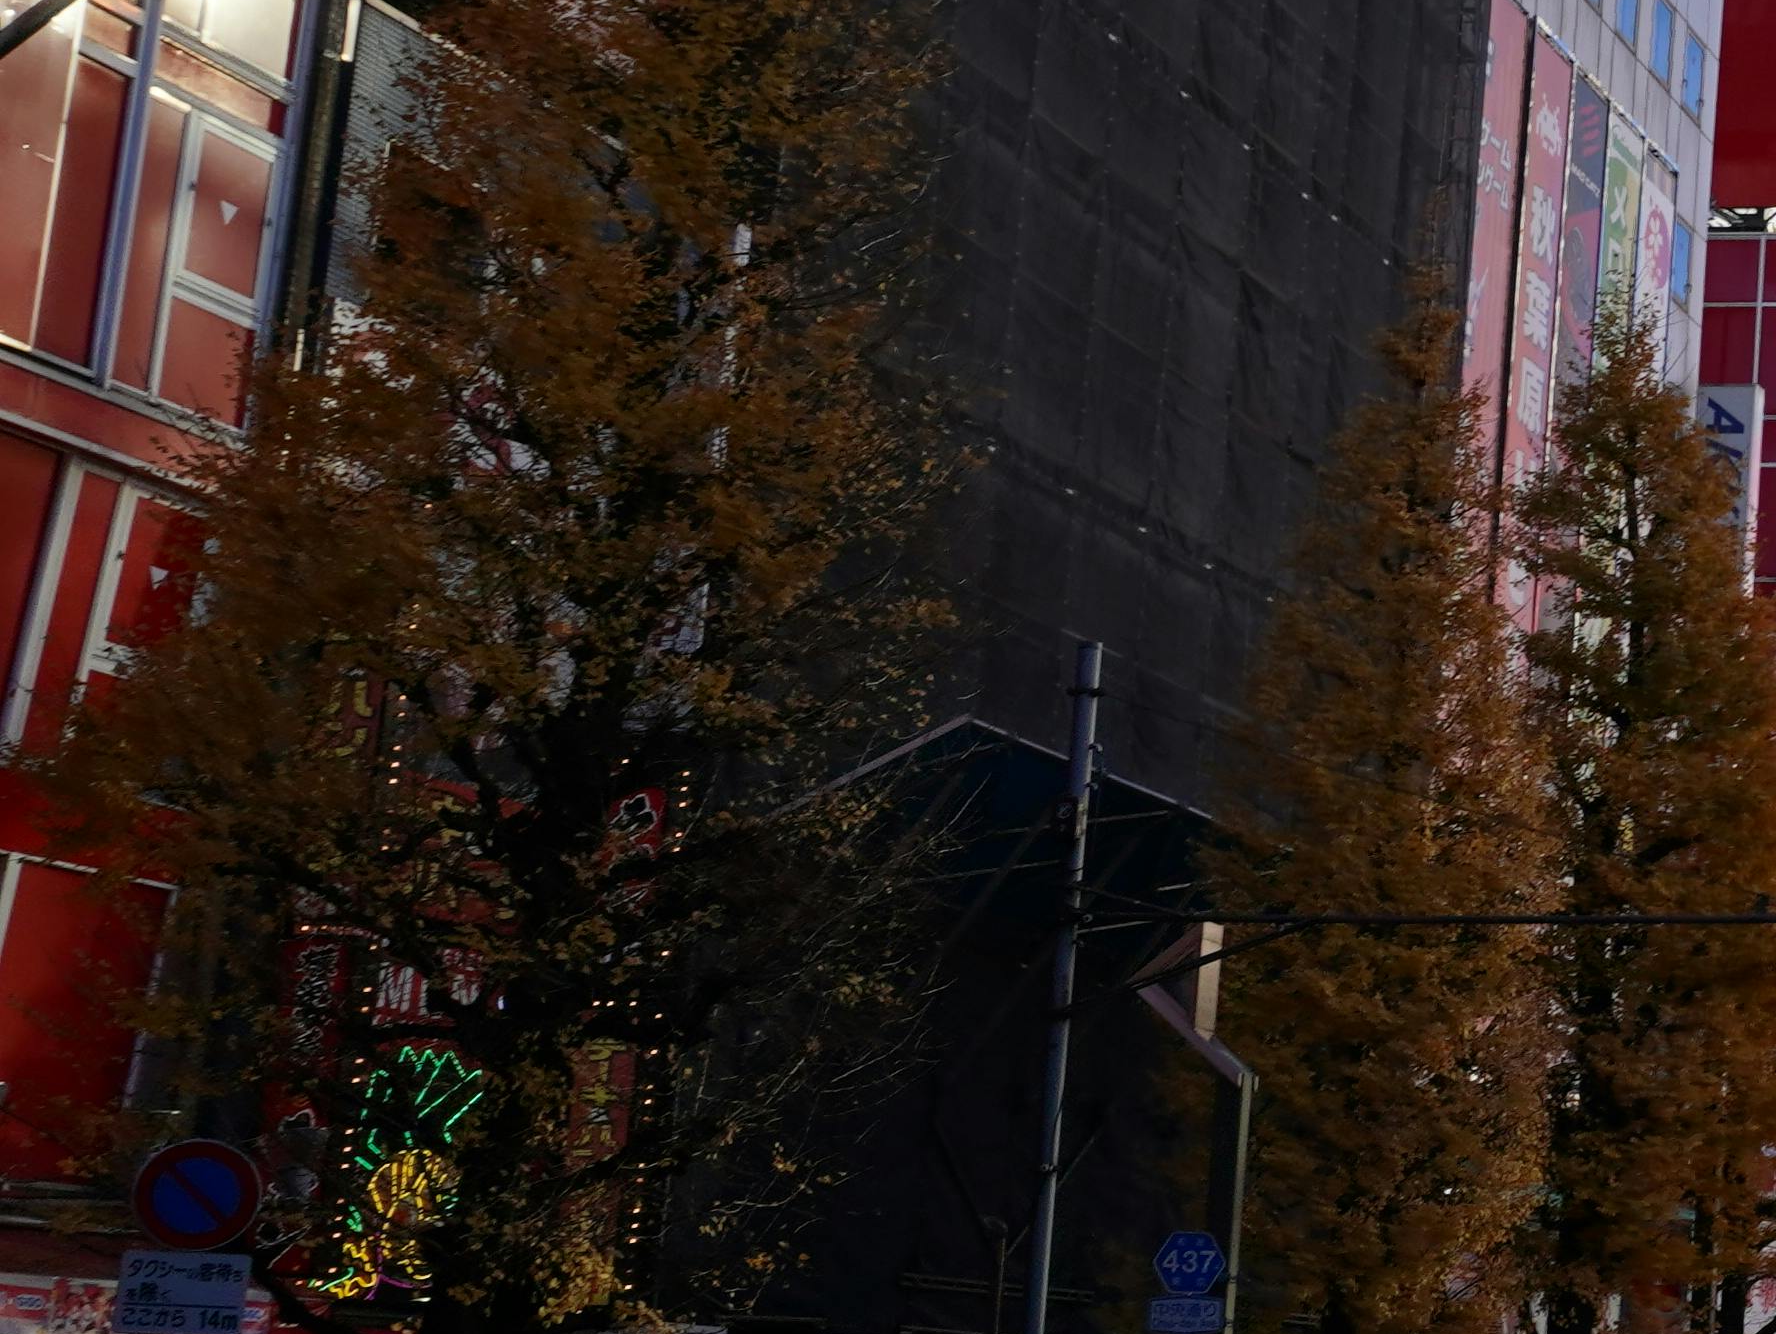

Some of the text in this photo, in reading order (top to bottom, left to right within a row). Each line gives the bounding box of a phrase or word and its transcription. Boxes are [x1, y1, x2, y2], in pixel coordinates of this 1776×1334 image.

[1161, 1248, 1218, 1274] 437
[121, 1307, 238, 1331] ここから 14m
